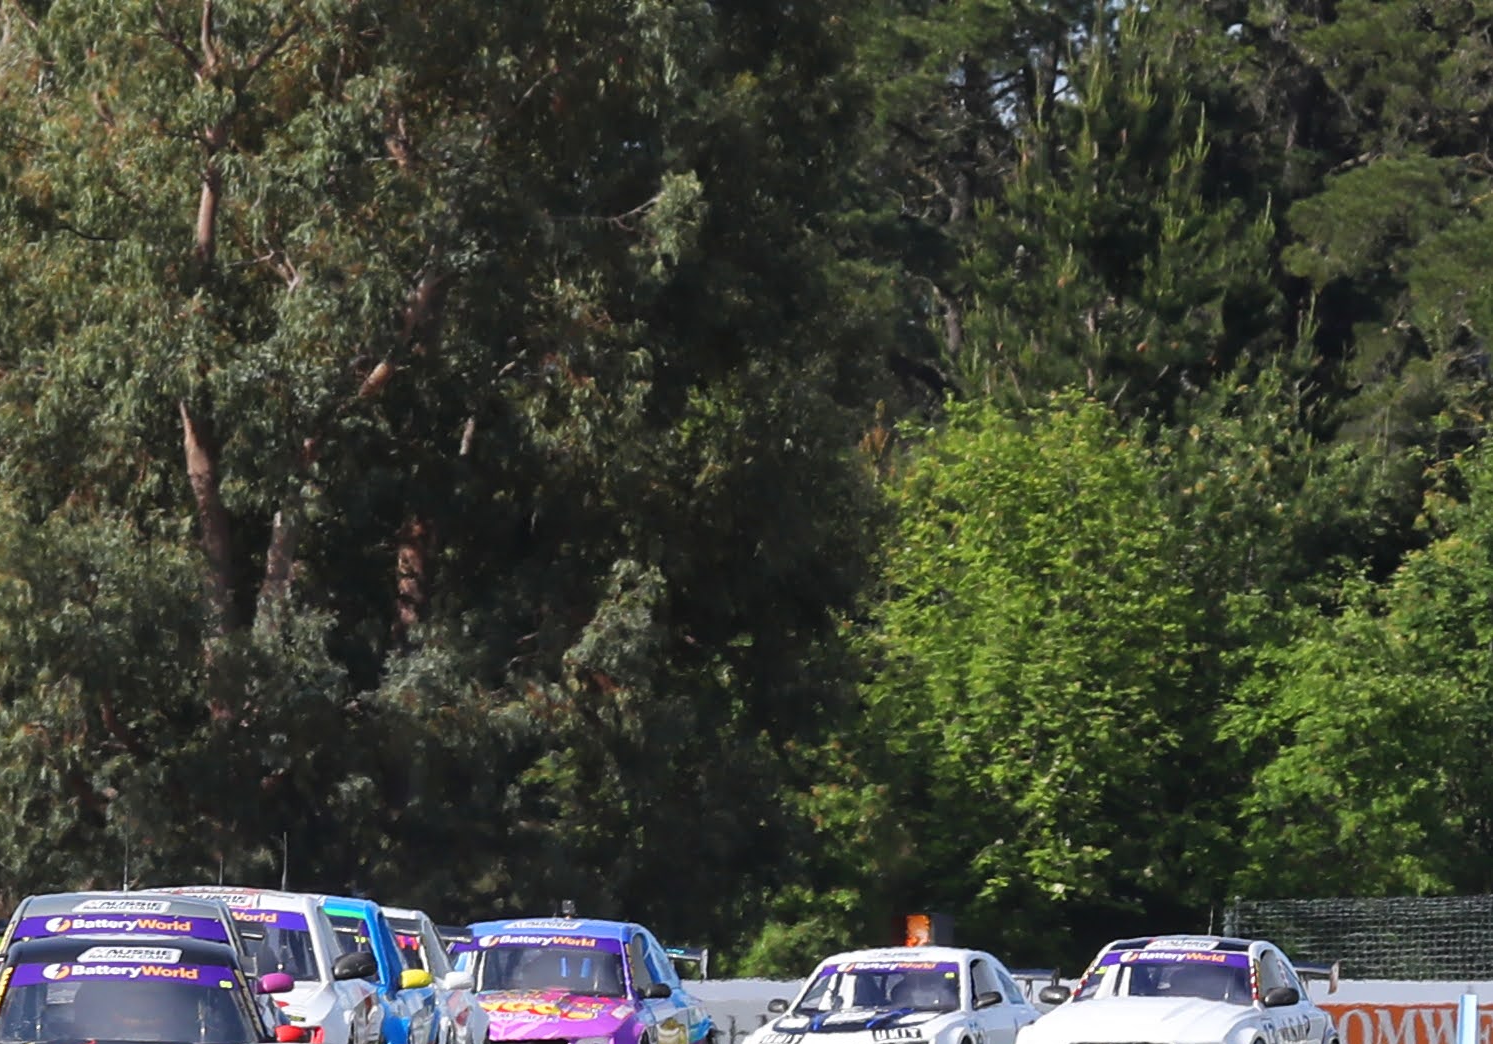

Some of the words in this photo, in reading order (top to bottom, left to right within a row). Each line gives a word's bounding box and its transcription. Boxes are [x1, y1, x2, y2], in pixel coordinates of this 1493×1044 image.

[71, 918, 192, 931] BatteryWorld
[499, 935, 596, 948] BatteryWorld
[71, 965, 199, 981] BatteryWorld
